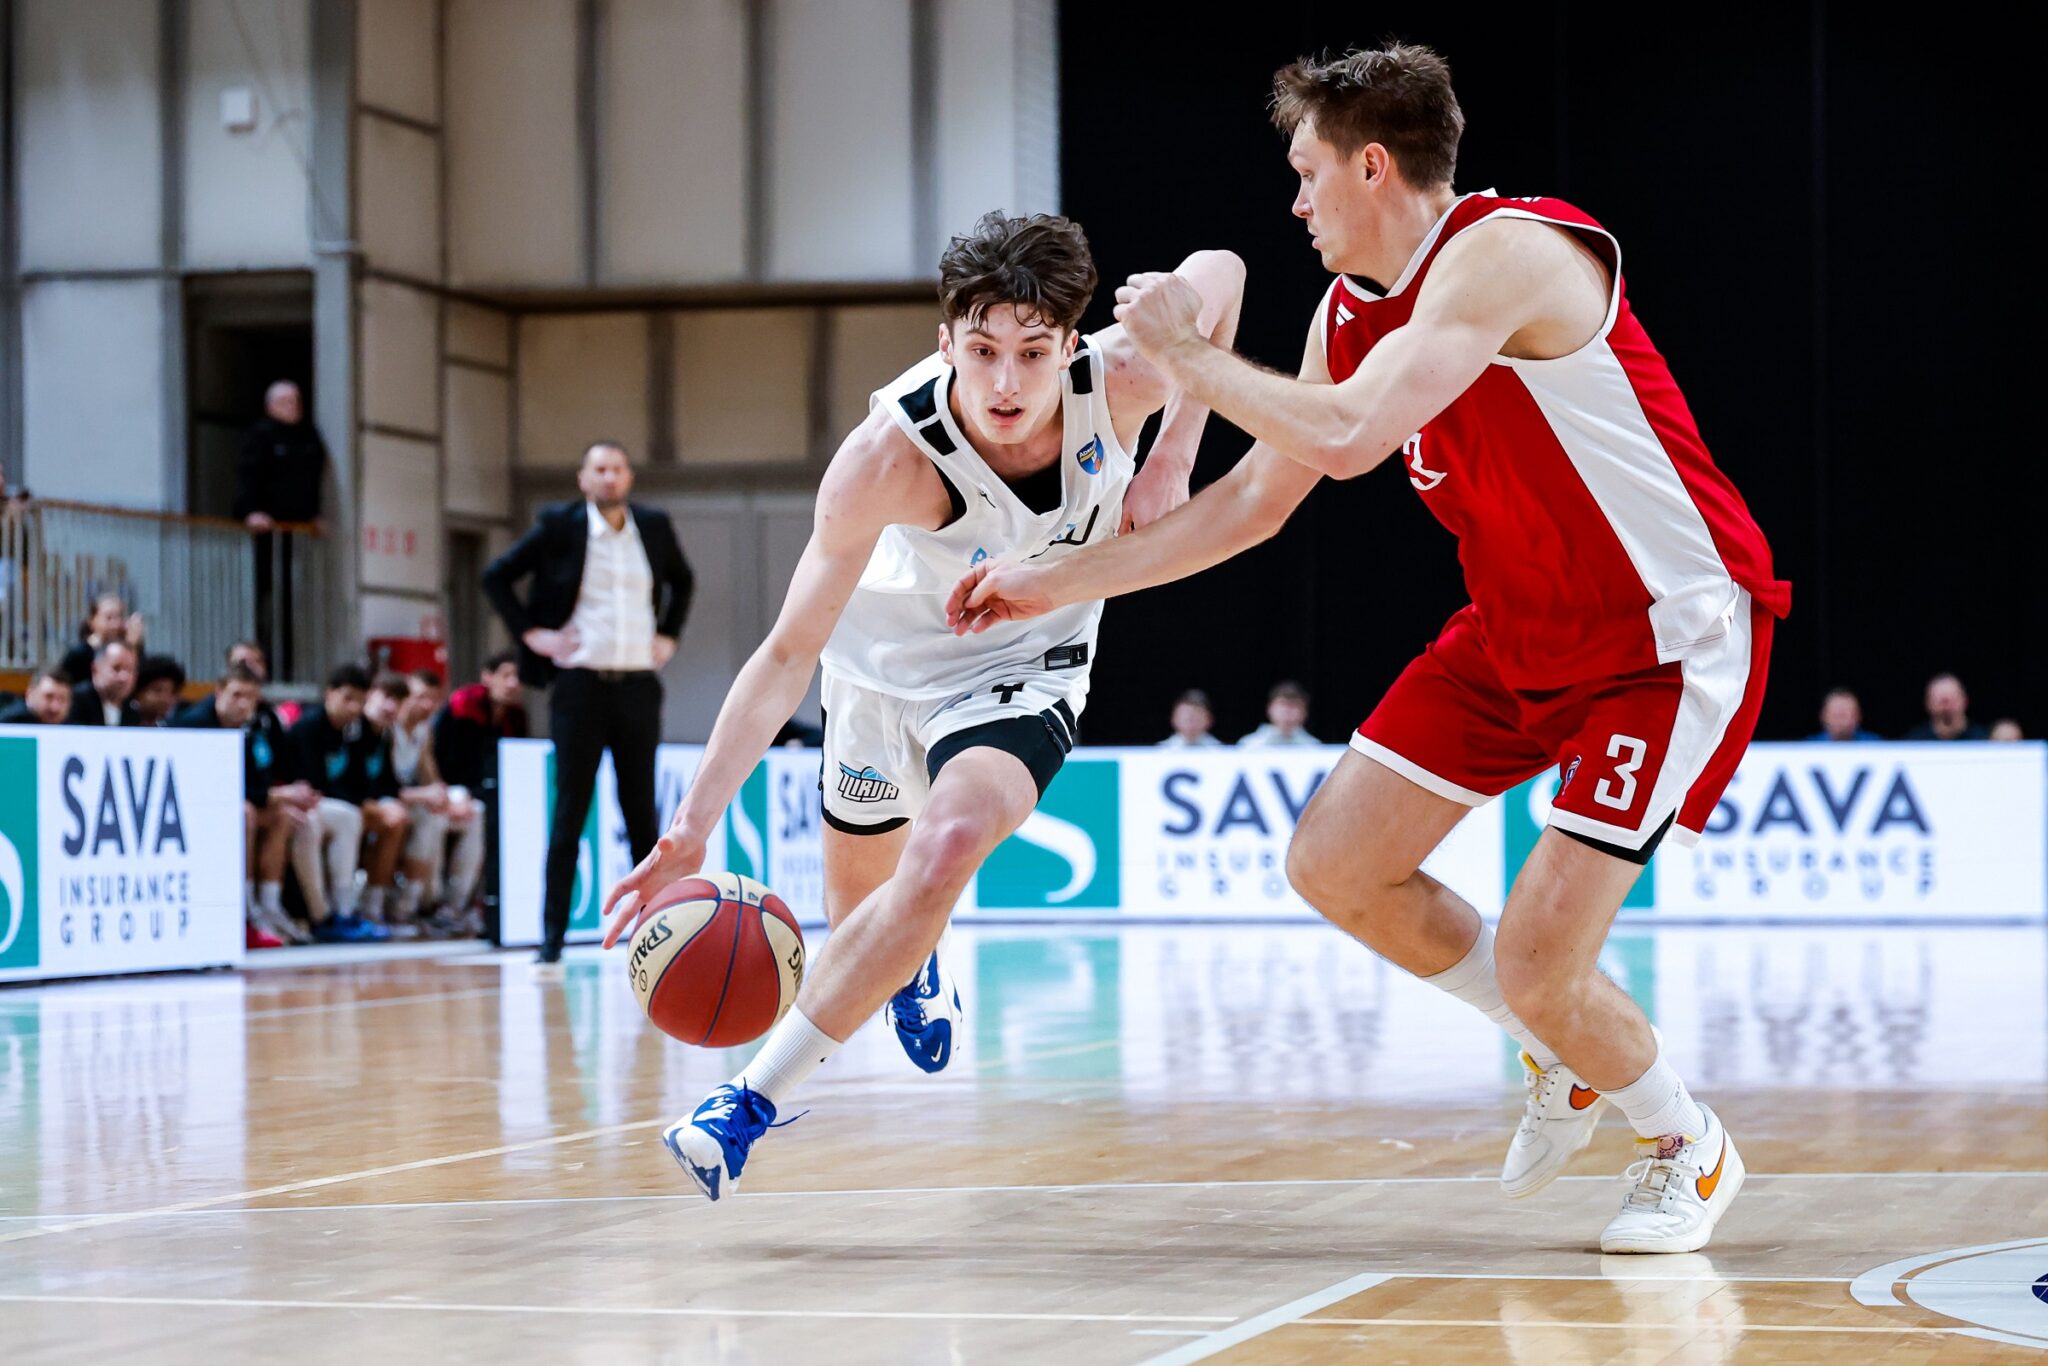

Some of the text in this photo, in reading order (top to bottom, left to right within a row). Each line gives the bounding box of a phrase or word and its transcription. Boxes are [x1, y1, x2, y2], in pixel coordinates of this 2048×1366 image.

[1594, 734, 1647, 811] 3
[62, 755, 187, 857] SAVA
[1161, 771, 1325, 837] SAV
[1696, 849, 1934, 870] INSURANCE
[60, 871, 190, 907] INSURANCE
[1159, 877, 1285, 898] GRO
[1696, 878, 1934, 899] GROUP
[60, 912, 190, 946] GROUP
[629, 914, 673, 992] SPALD
